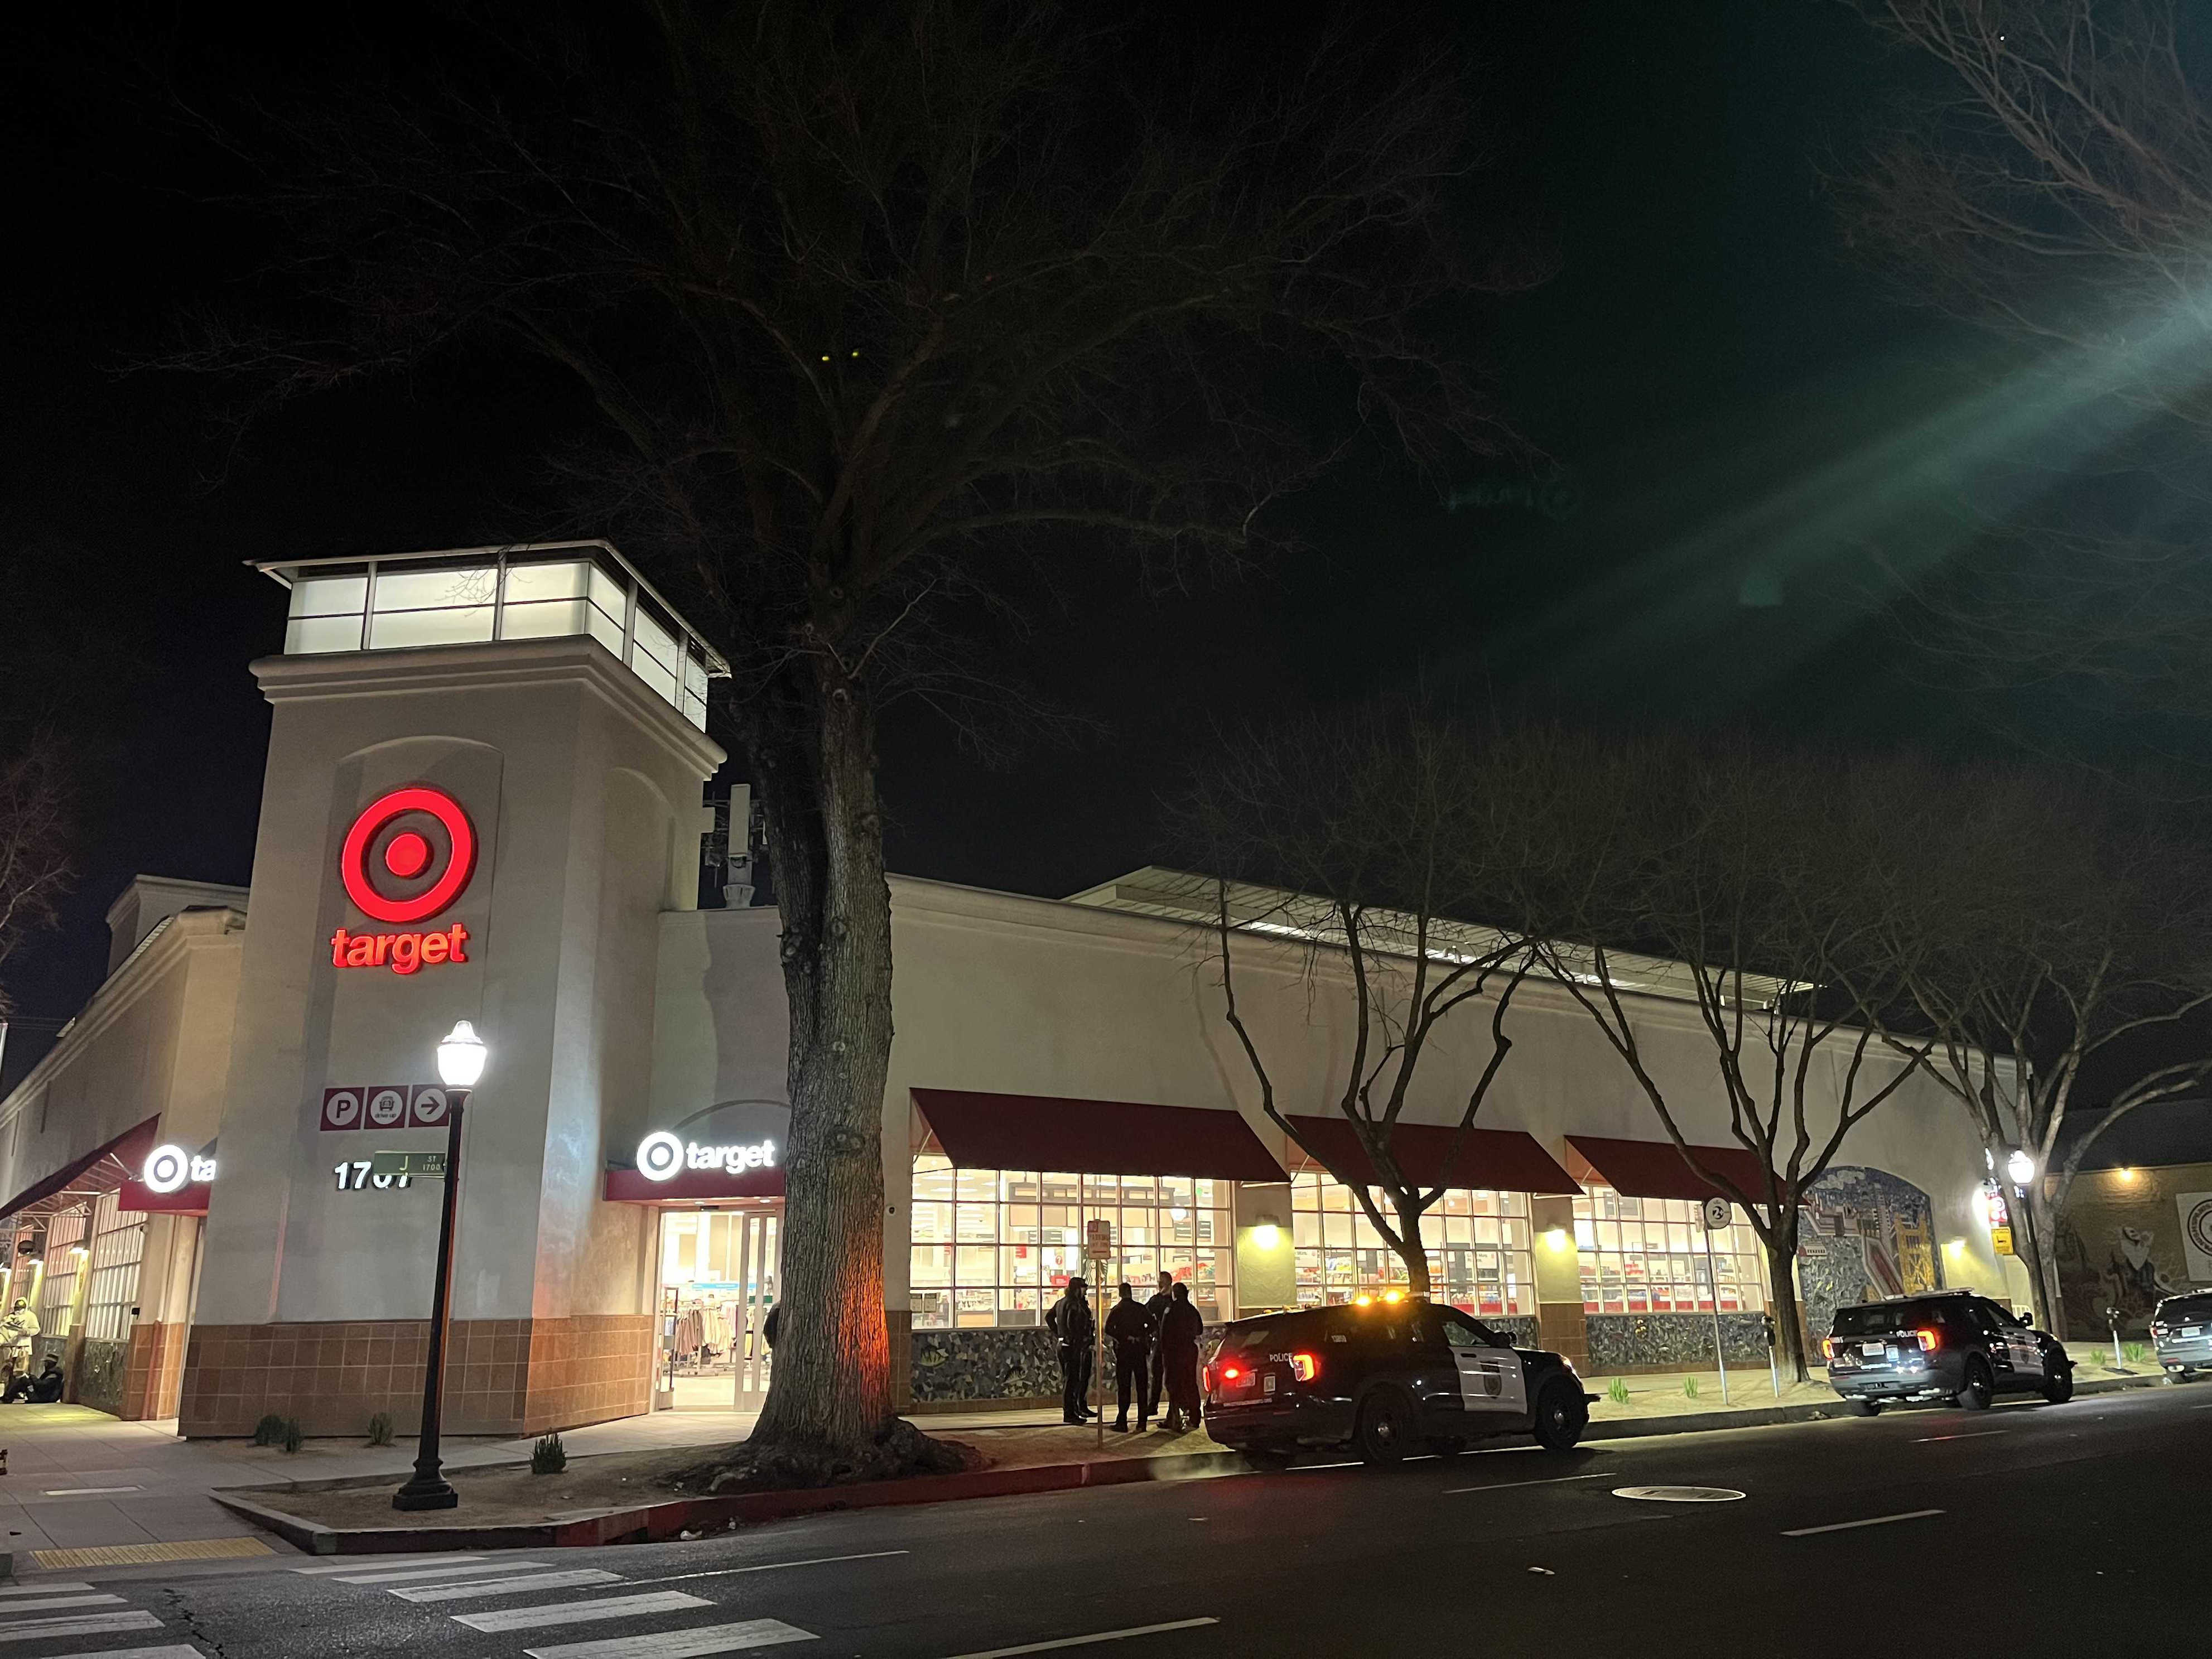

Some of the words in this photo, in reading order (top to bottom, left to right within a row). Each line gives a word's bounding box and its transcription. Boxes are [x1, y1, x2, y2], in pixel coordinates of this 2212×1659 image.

[331, 923, 468, 974] target
[336, 1099, 350, 1118] P
[399, 1155, 408, 1171] J
[686, 1140, 775, 1174] target
[1269, 1352, 1293, 1362] POLICE
